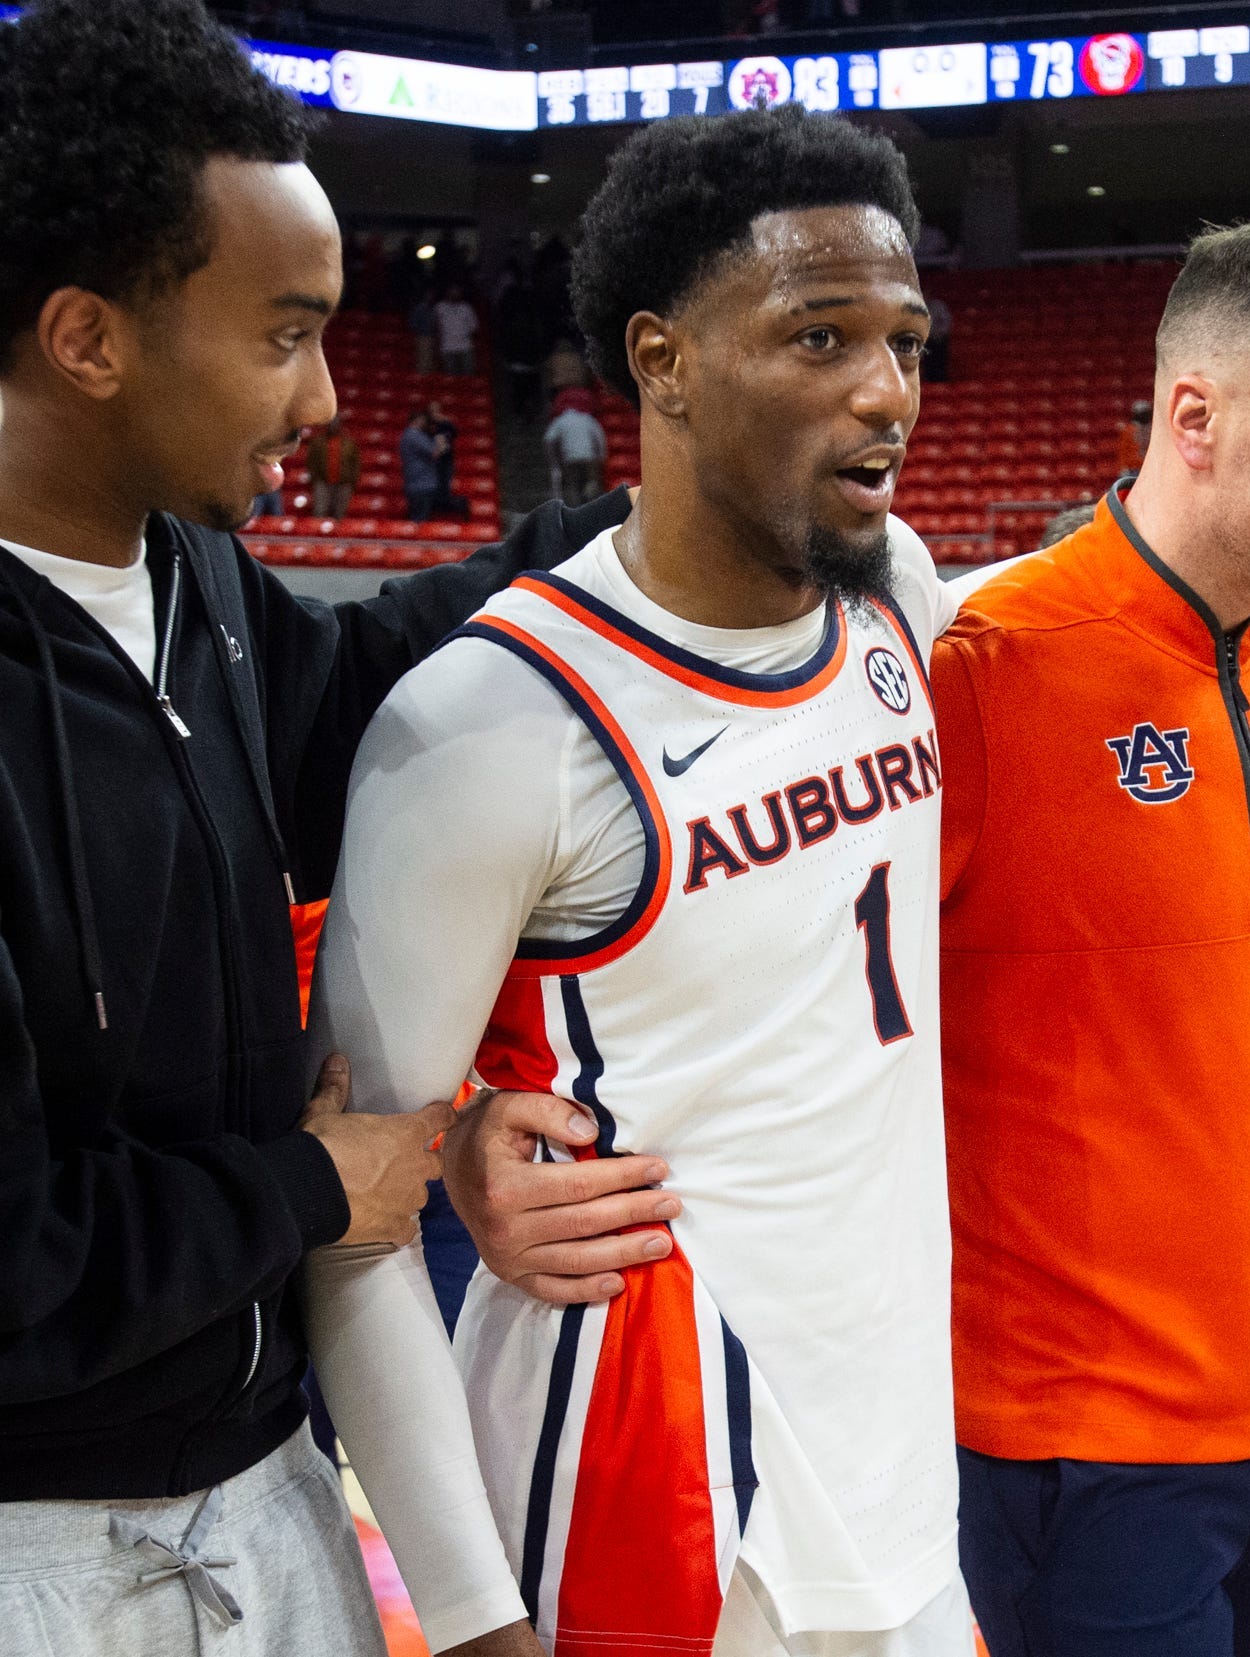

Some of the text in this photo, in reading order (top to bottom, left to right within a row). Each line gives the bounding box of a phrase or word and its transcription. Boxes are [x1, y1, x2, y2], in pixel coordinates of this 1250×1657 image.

[1027, 40, 1074, 98] 73
[868, 650, 910, 711] SEC
[683, 728, 943, 895] AUBURN
[855, 860, 914, 1046] 1
